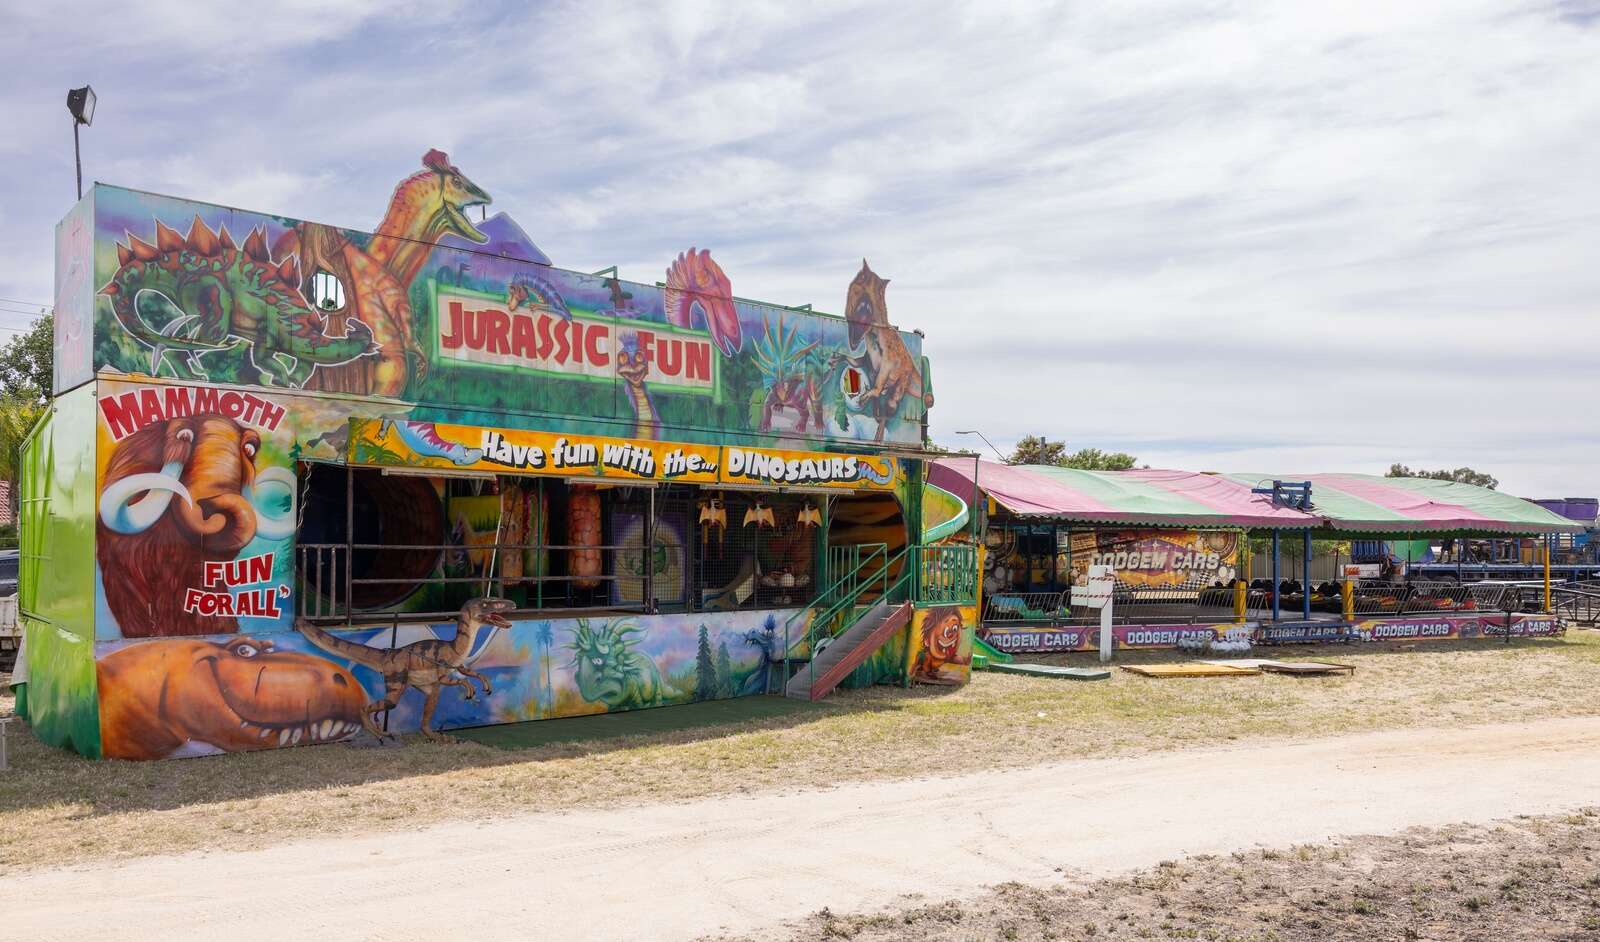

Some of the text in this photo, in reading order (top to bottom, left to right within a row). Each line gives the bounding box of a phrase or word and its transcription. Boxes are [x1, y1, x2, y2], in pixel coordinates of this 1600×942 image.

[441, 301, 610, 367] JURASSIC
[100, 387, 285, 441] MAMMOTH
[481, 431, 546, 469] Have
[551, 438, 598, 468] fun
[602, 443, 655, 477] with
[728, 448, 870, 483] DINOSAURS
[204, 552, 275, 588] FUN
[1092, 551, 1220, 570] DODGEM CARS
[1044, 632, 1079, 646] CARS
[1127, 630, 1179, 645] DODGEM
[1375, 623, 1449, 637] DODGEM CARS
[1528, 621, 1551, 632] CARS
